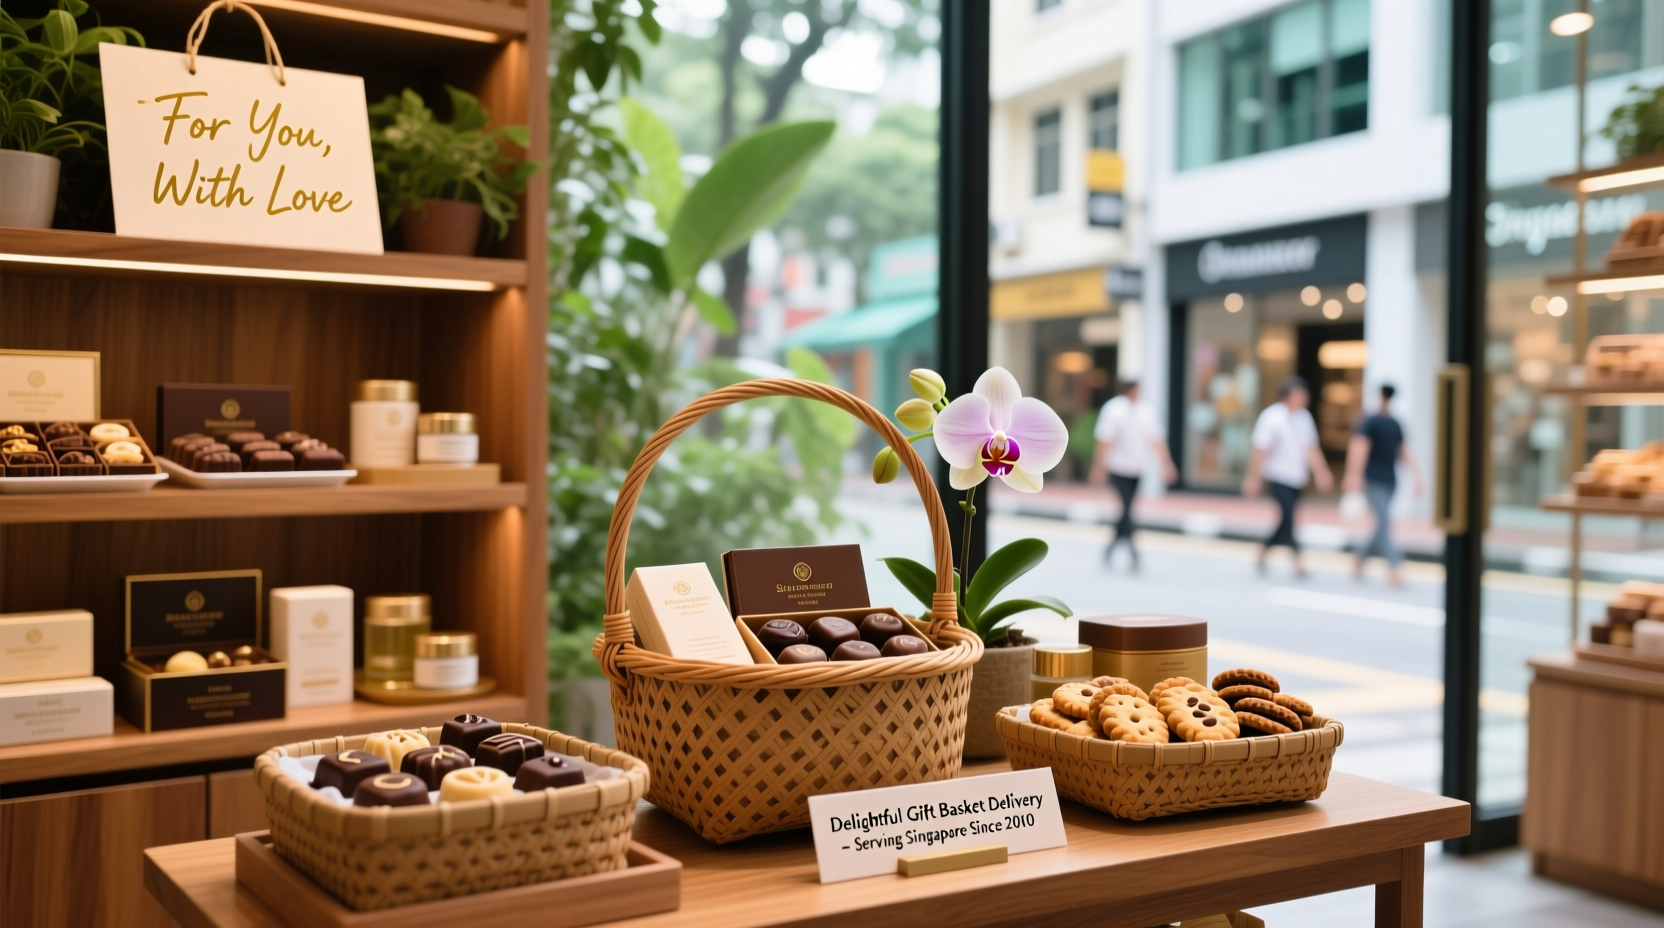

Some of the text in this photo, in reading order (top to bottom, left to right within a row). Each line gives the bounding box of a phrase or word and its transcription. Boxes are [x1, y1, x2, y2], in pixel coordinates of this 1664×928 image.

[155, 91, 331, 163] For You,
[153, 159, 353, 216] With Love
[830, 792, 1043, 833] Delightful Gift Basket Delivery
[854, 832, 904, 851] Serving
[905, 825, 967, 845] Singapore
[969, 818, 1003, 836] Since
[1004, 812, 1035, 830] 2010
